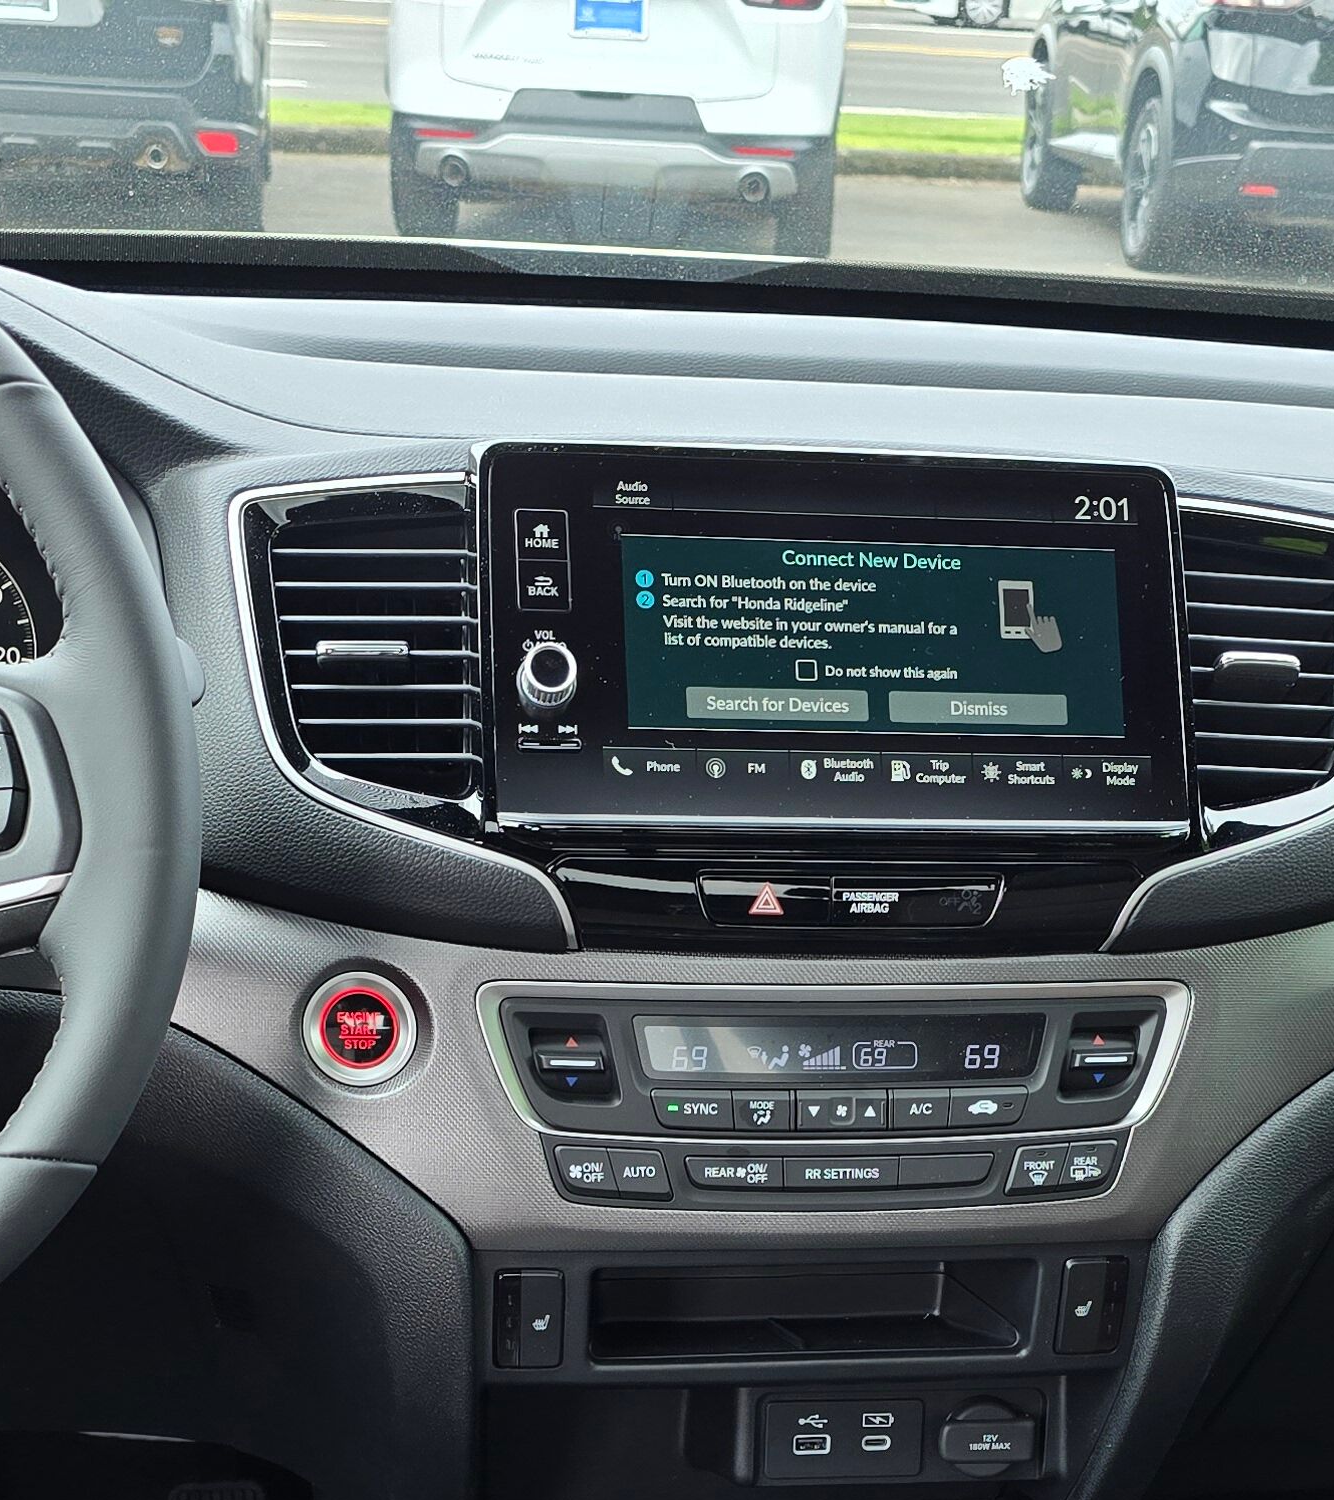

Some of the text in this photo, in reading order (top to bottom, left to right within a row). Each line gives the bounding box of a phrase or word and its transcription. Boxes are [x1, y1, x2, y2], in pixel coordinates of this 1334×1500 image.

[617, 481, 648, 492] Audio
[615, 494, 650, 505] Source
[1075, 495, 1129, 521] 2:01
[525, 538, 559, 549] HOME
[782, 550, 961, 570] Connect New Device
[661, 573, 692, 588] Turn
[694, 574, 718, 588] ON
[722, 575, 786, 590] Bluetooth
[789, 580, 806, 591] on
[809, 577, 831, 591] the
[834, 578, 876, 592] device
[528, 586, 559, 596] BACK
[662, 595, 706, 609] Search
[709, 595, 729, 609] for
[731, 596, 780, 611] "Honda
[784, 598, 848, 613] Ridgeline"
[663, 615, 958, 636] Visit the website in your owner's manual for a
[534, 630, 556, 640] VOL
[665, 633, 832, 650] list of compatible devices.
[825, 665, 957, 681] Do not show this again
[706, 696, 849, 714] Search for Devices
[950, 701, 1007, 716] Dismiss
[647, 761, 681, 772] Phone
[748, 763, 766, 774] FM
[823, 758, 874, 769] Bluetooth
[930, 760, 949, 772] Trip
[1016, 761, 1045, 772] Smart
[1102, 762, 1138, 775] Display
[834, 771, 865, 782] Audio
[916, 773, 966, 786] Computer
[1008, 774, 1055, 785] Shortcuts
[1106, 776, 1135, 786] Mode
[843, 892, 899, 902] PASSENGER
[850, 903, 889, 913] AIRBAG
[340, 1025, 377, 1035] START
[345, 1039, 376, 1049] STOP
[873, 1039, 896, 1048] REAR
[671, 1046, 707, 1071] 69
[859, 1048, 887, 1067] 69
[964, 1045, 1000, 1069] 69
[683, 1103, 718, 1115] SYNC
[749, 1101, 775, 1110] MODE
[909, 1103, 932, 1115] A/C
[1024, 1160, 1055, 1170] FRONT
[1074, 1156, 1097, 1166] REAR
[583, 1162, 603, 1172] ON/
[623, 1166, 656, 1178] AUTO
[705, 1167, 735, 1178] REAR
[747, 1163, 767, 1174] ON/
[584, 1173, 604, 1183] OFF
[747, 1174, 768, 1184] OFF
[805, 1168, 880, 1180] RR SETTINGS
[983, 1434, 999, 1442] 12V
[991, 1442, 1011, 1450] MAX
